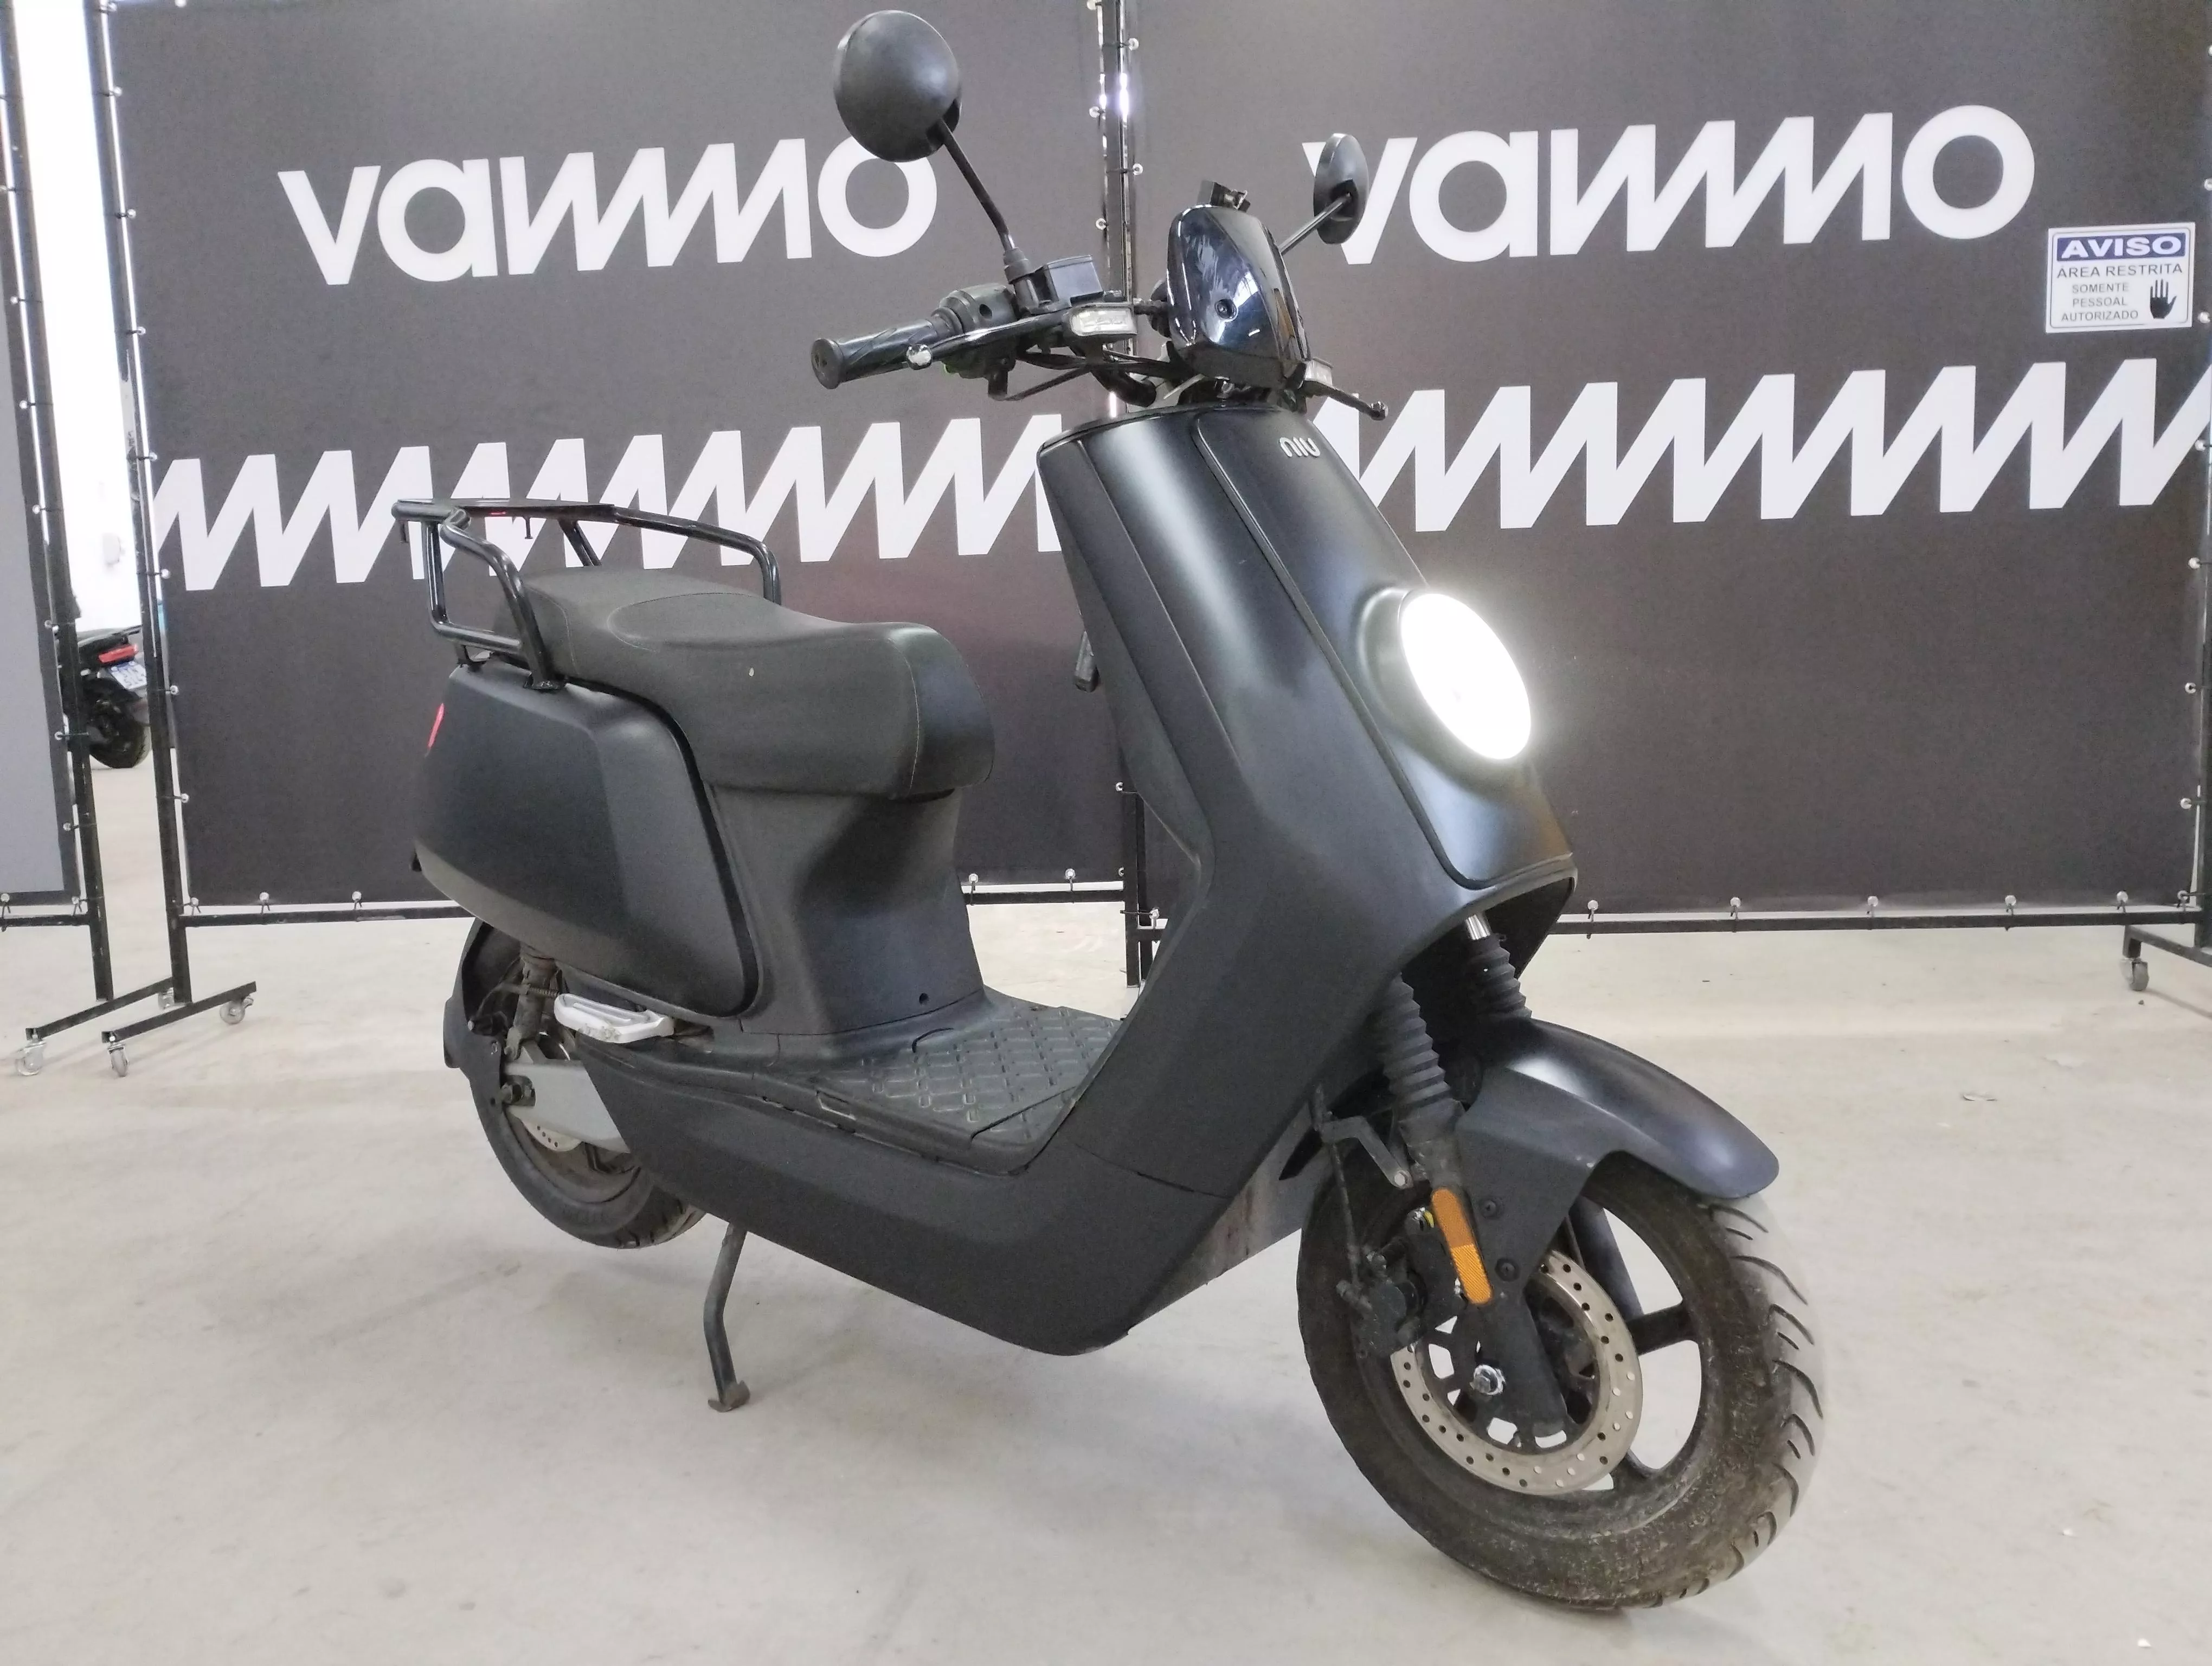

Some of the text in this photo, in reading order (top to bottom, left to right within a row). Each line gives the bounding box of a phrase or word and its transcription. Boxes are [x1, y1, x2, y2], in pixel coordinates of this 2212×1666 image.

[2061, 236, 2182, 259] AVISO
[2106, 263, 2183, 277] RESTRITA
[2072, 282, 2130, 294] SOMENTE
[2072, 296, 2127, 308] PESSOAL
[2061, 310, 2138, 322] AUTORIZADO
